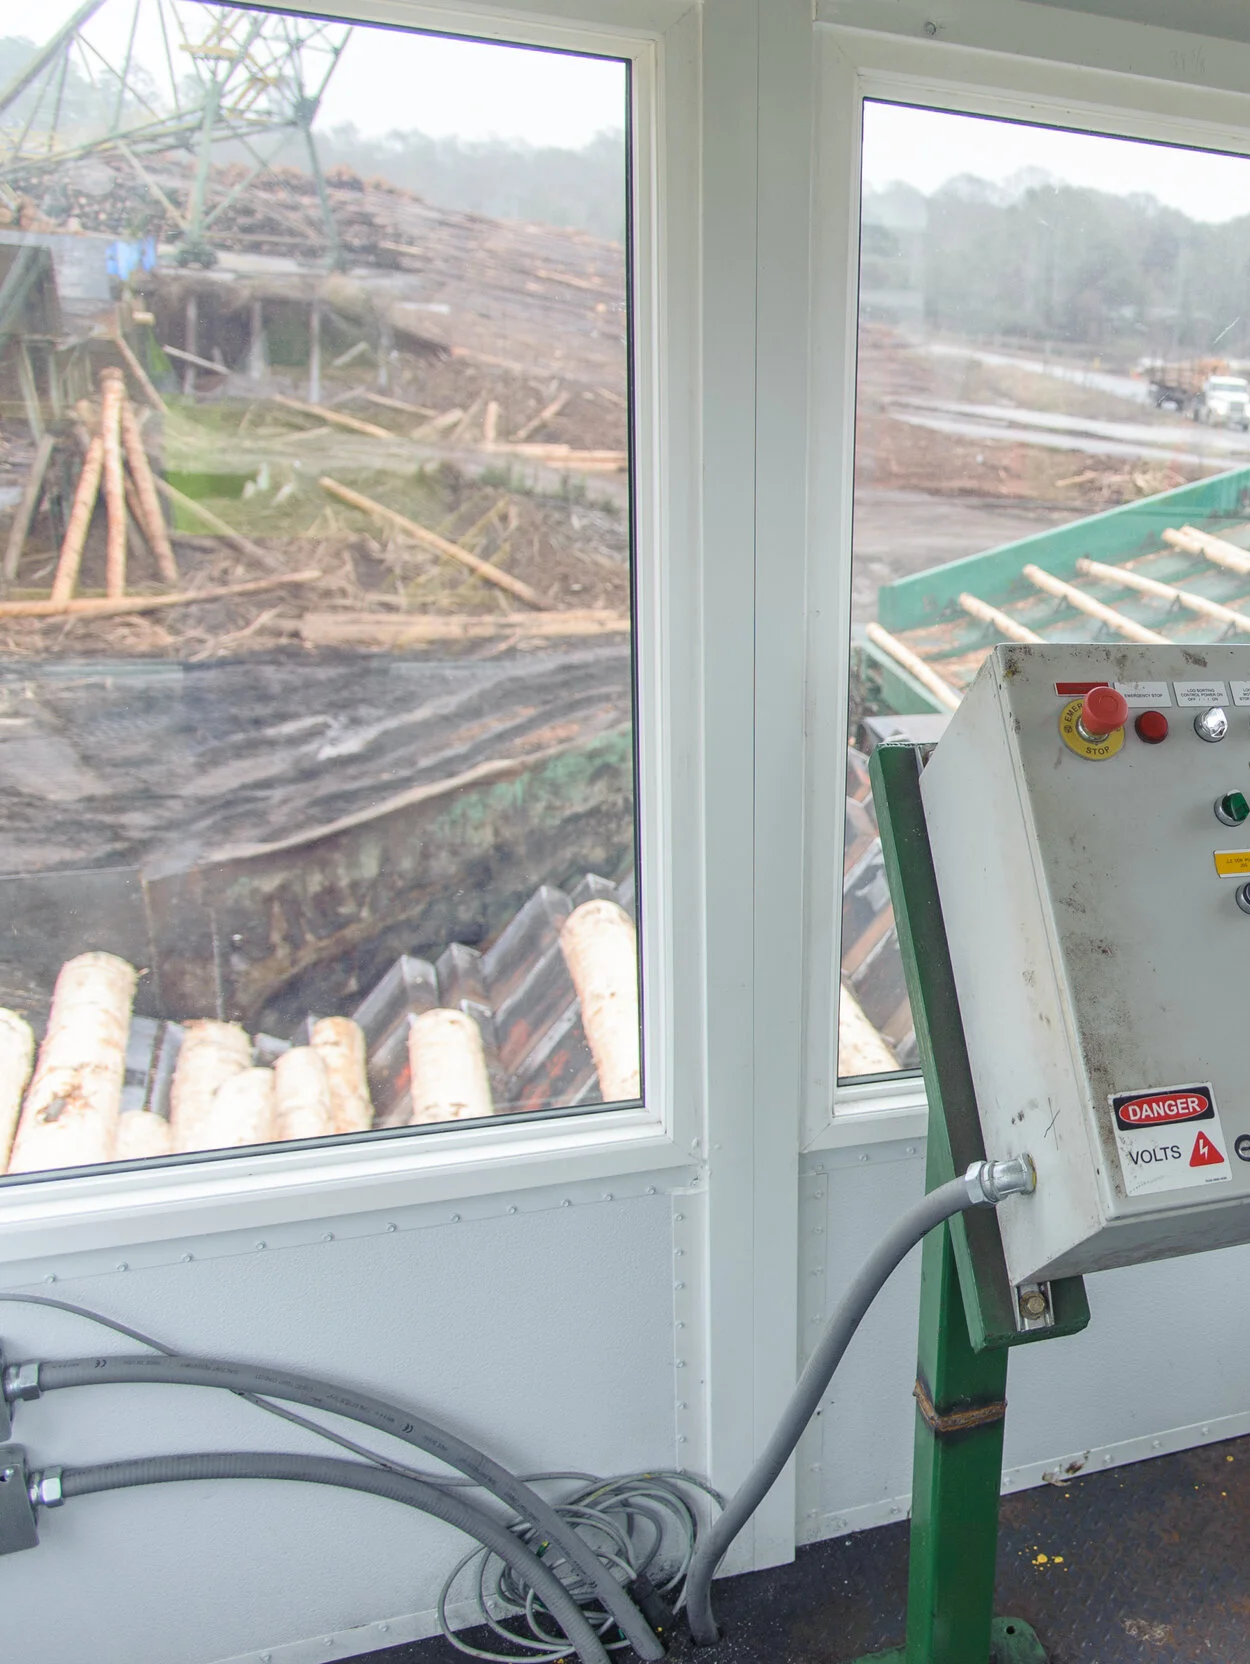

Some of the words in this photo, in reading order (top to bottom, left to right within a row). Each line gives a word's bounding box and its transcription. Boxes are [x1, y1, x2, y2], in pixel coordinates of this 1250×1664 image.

[1086, 746, 1110, 755] STOP
[1128, 1097, 1201, 1121] DANGER
[1129, 1145, 1182, 1165] VOLTS
